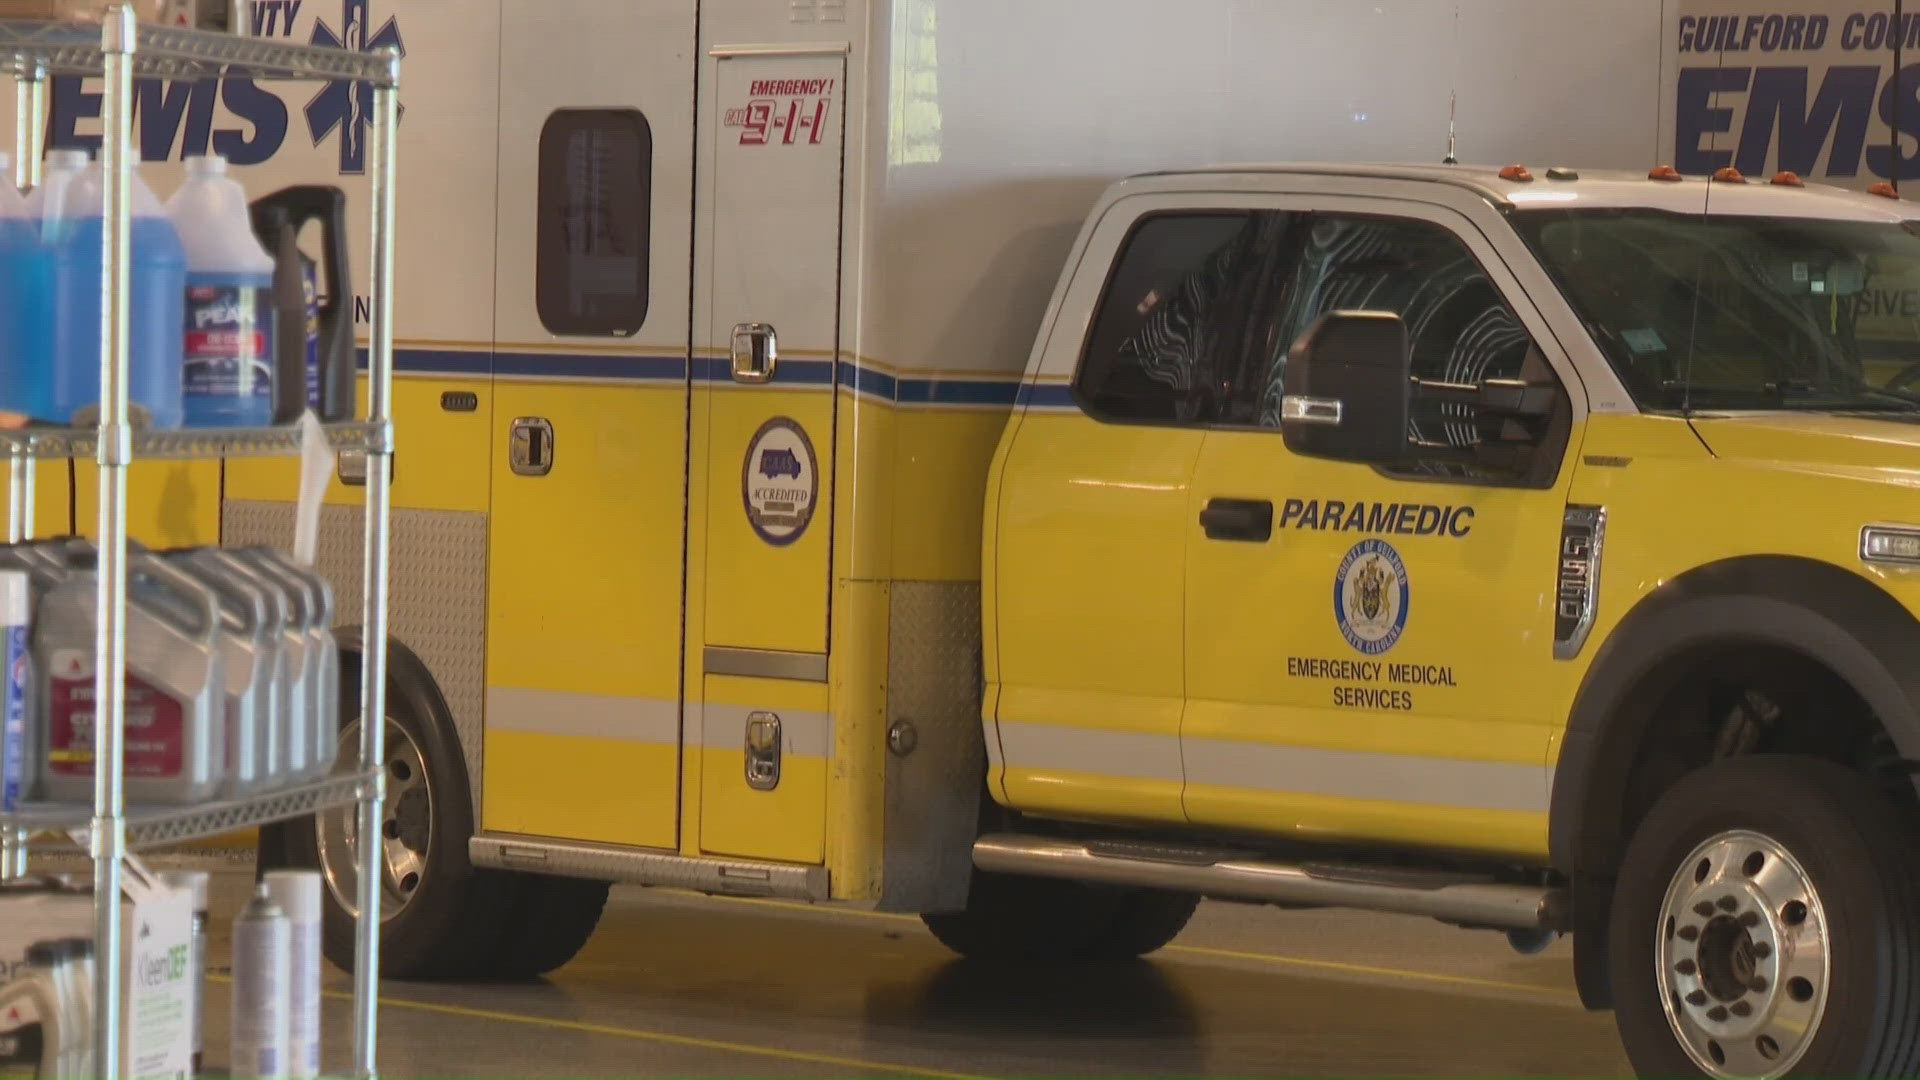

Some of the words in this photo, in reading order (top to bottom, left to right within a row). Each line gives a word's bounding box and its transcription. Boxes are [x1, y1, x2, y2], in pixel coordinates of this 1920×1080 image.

[1679, 15, 1829, 52] GUILFORD
[43, 64, 288, 166] EMS
[739, 99, 831, 145] 9-1-1
[1675, 63, 1920, 180] EMS
[753, 487, 808, 502] ACCREDITED
[1279, 498, 1475, 537] PARAMEDIC
[1337, 543, 1362, 581] COUNTY
[1364, 539, 1375, 552] OF
[1377, 540, 1407, 585] GUILFORD
[1340, 620, 1363, 653] NORTH
[1365, 624, 1402, 655] CAROLINA
[1287, 657, 1382, 681] EMERGENCY
[1388, 663, 1457, 687] MEDICAL
[1333, 686, 1412, 710] SERVICES
